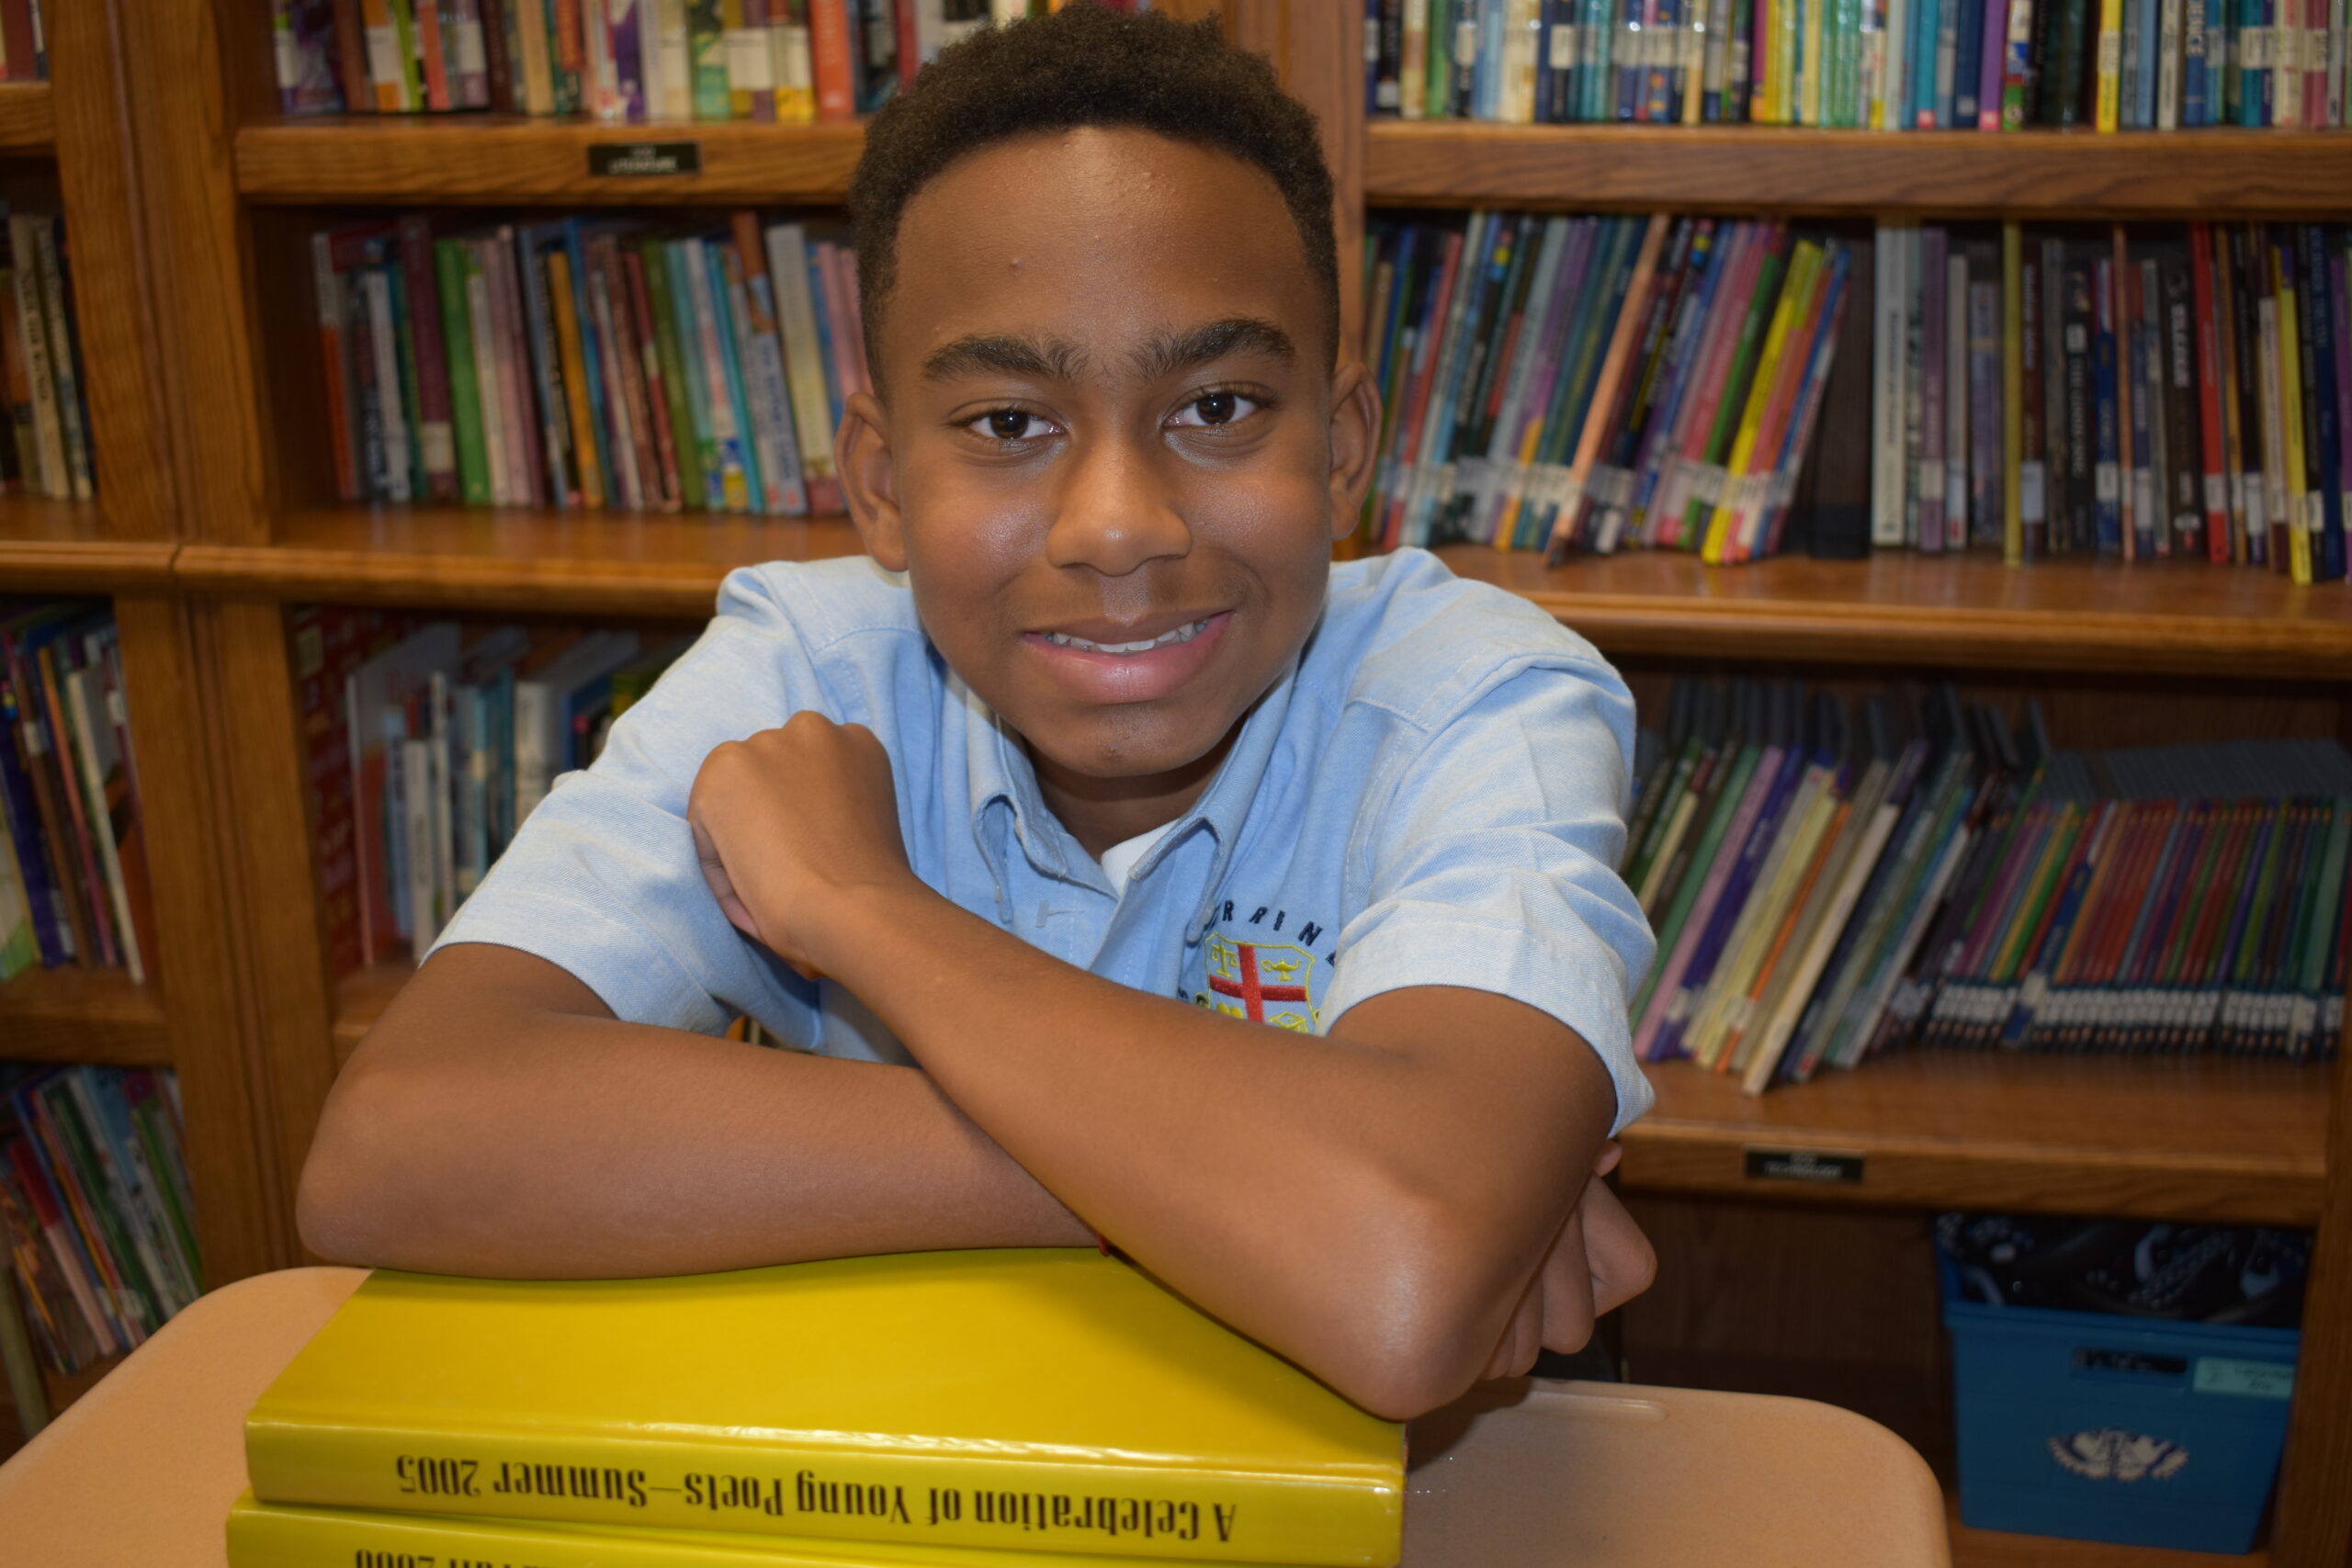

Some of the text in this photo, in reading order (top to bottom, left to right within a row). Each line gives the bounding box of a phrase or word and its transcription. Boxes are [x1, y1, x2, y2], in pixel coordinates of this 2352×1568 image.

[395, 1454, 482, 1497] 2005
[796, 1470, 912, 1525] Young
[926, 1486, 962, 1526] of
[974, 1490, 1200, 1540] Celebration
[1213, 1502, 1237, 1542] A
